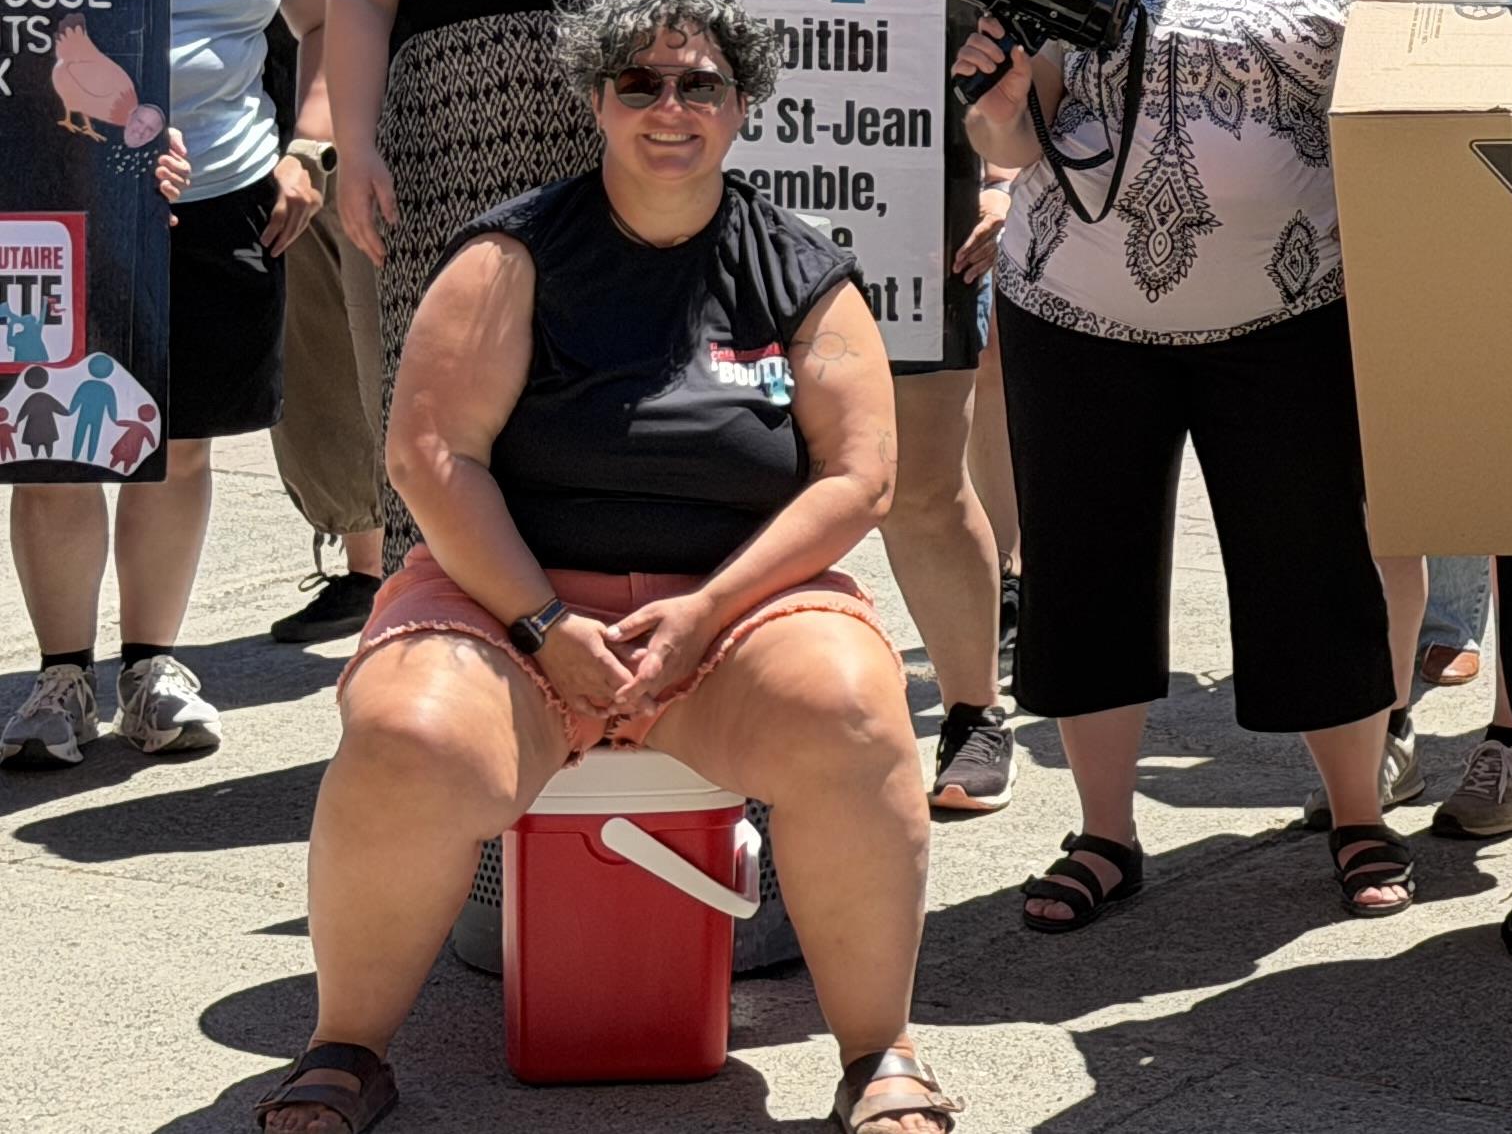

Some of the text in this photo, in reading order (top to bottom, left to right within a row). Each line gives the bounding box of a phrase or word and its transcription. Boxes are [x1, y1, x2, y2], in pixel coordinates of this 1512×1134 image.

[764, 18, 888, 72] bitibi
[776, 98, 932, 148] St-Jean
[728, 165, 888, 217] emble,
